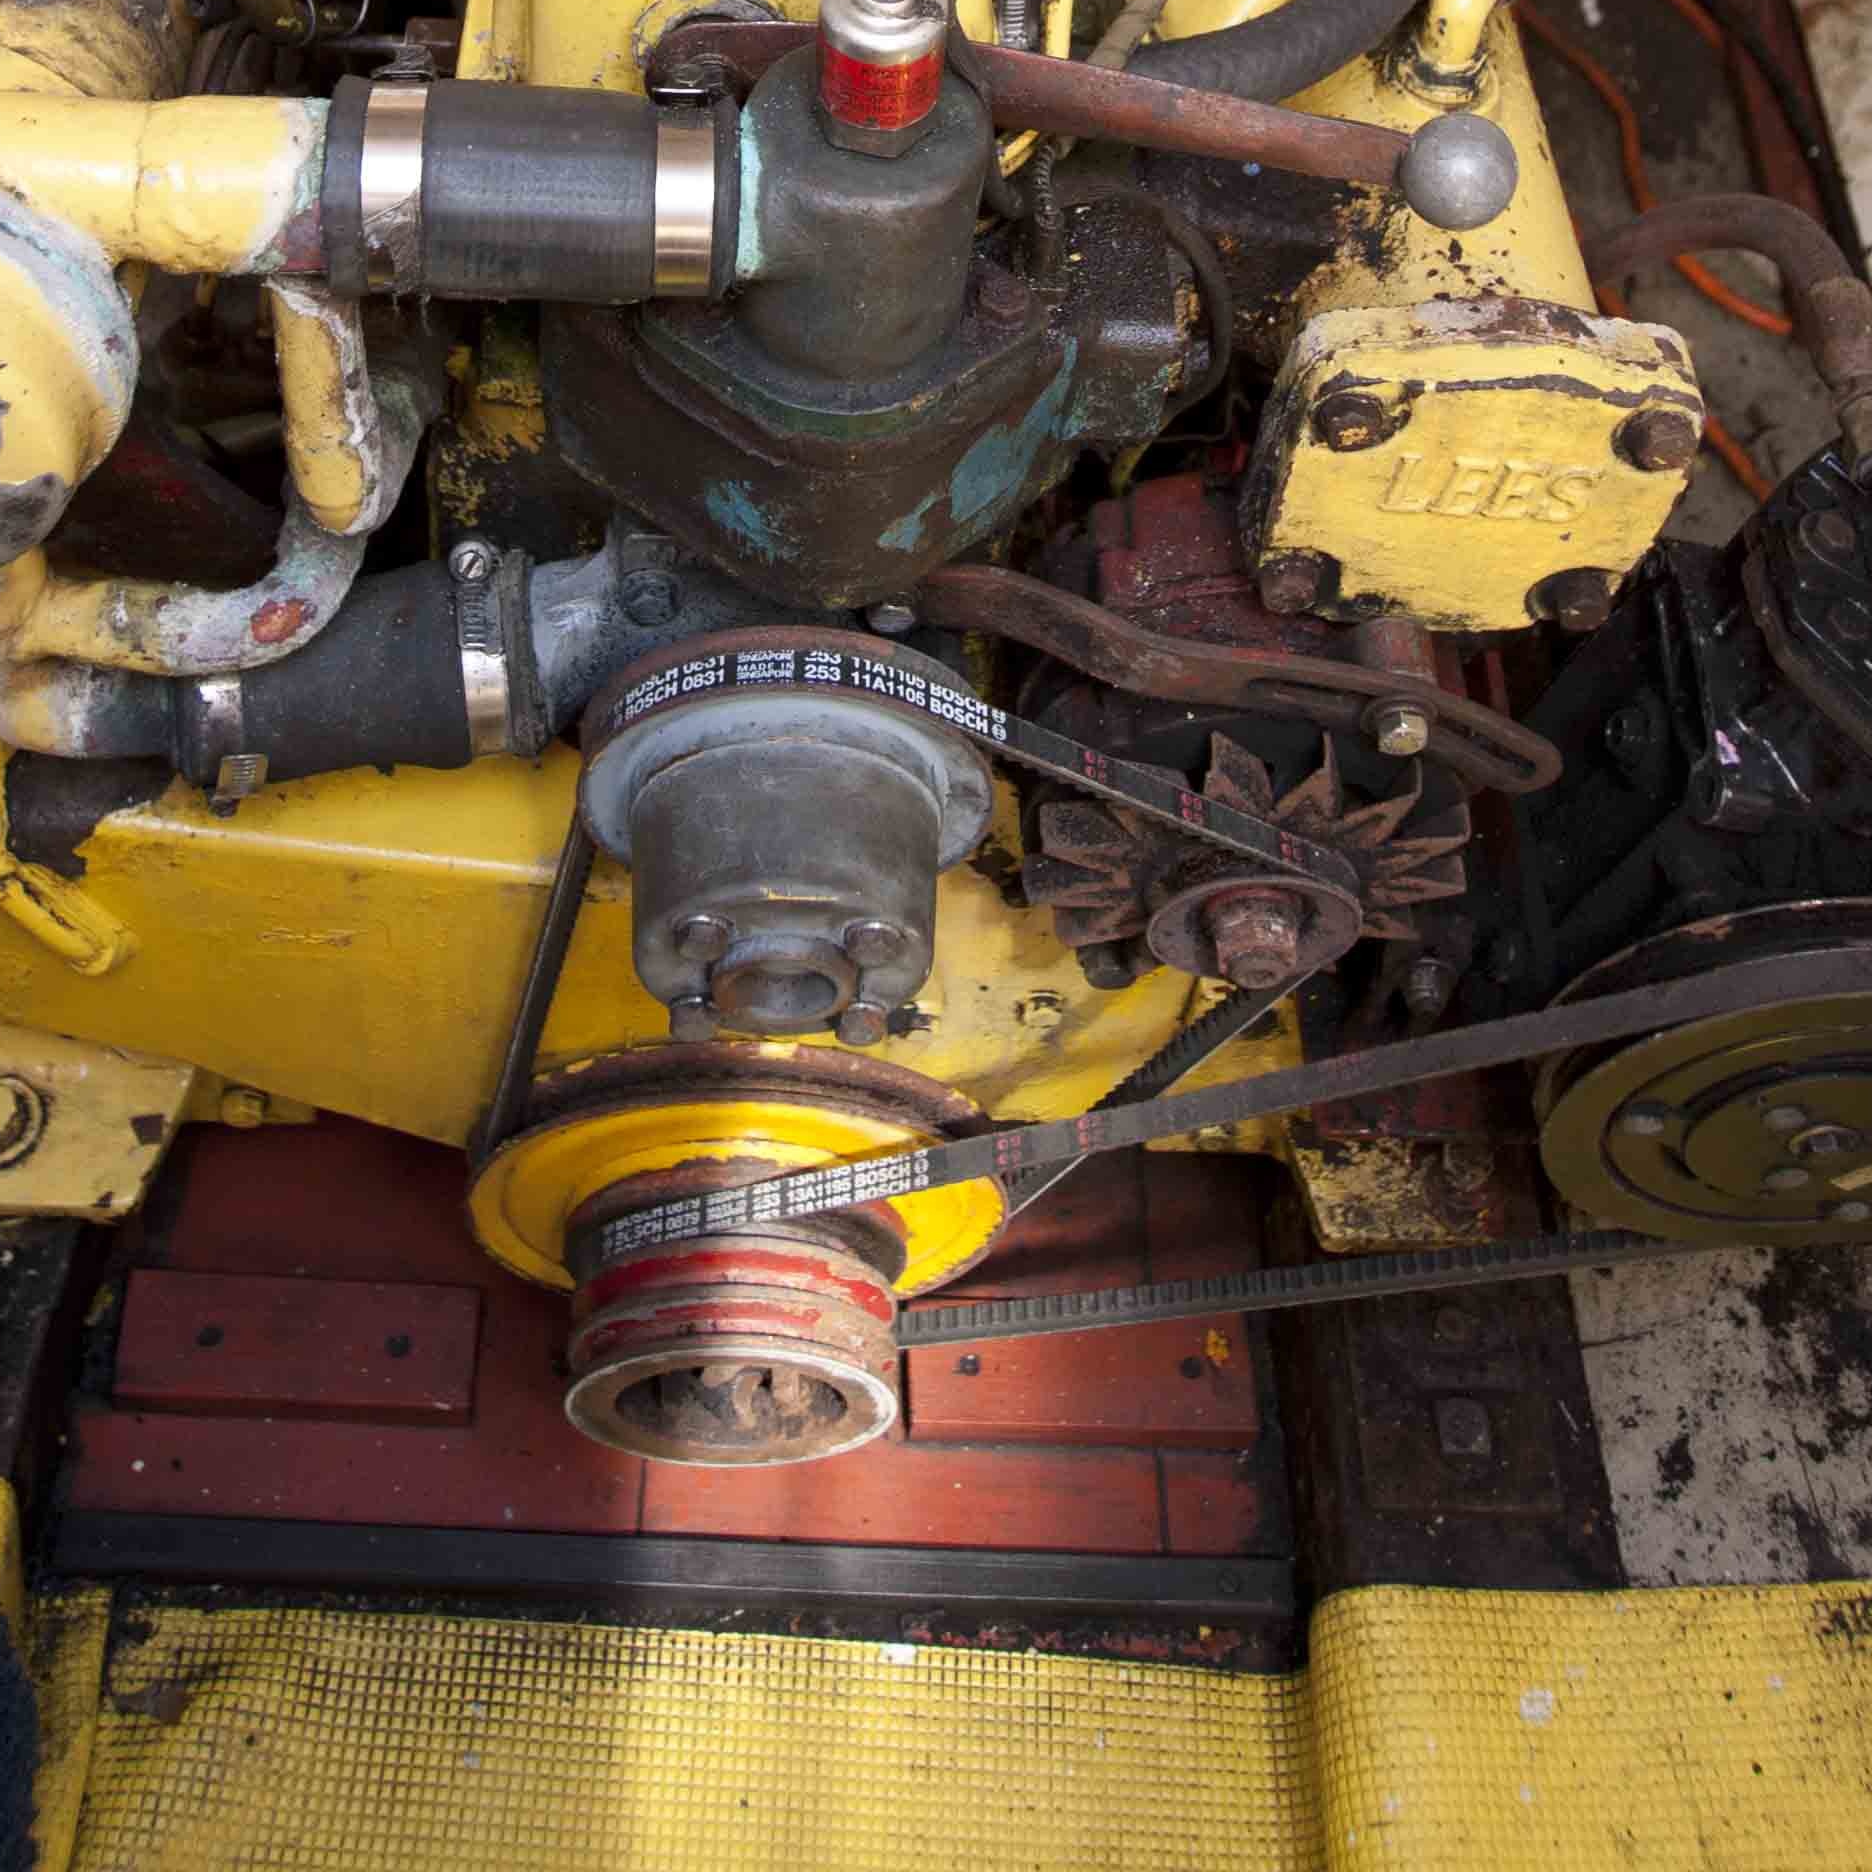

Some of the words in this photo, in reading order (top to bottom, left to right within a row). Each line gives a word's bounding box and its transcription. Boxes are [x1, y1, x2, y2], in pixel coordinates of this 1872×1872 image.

[1378, 454, 1604, 524] LEES
[625, 681, 678, 721] BOSCH
[682, 668, 726, 692] 0831
[804, 664, 842, 682] 253
[850, 671, 927, 708] 11A1105
[929, 697, 989, 734] BOSCH
[929, 683, 989, 717] BOSCH
[854, 1162, 911, 1188] BOSCH
